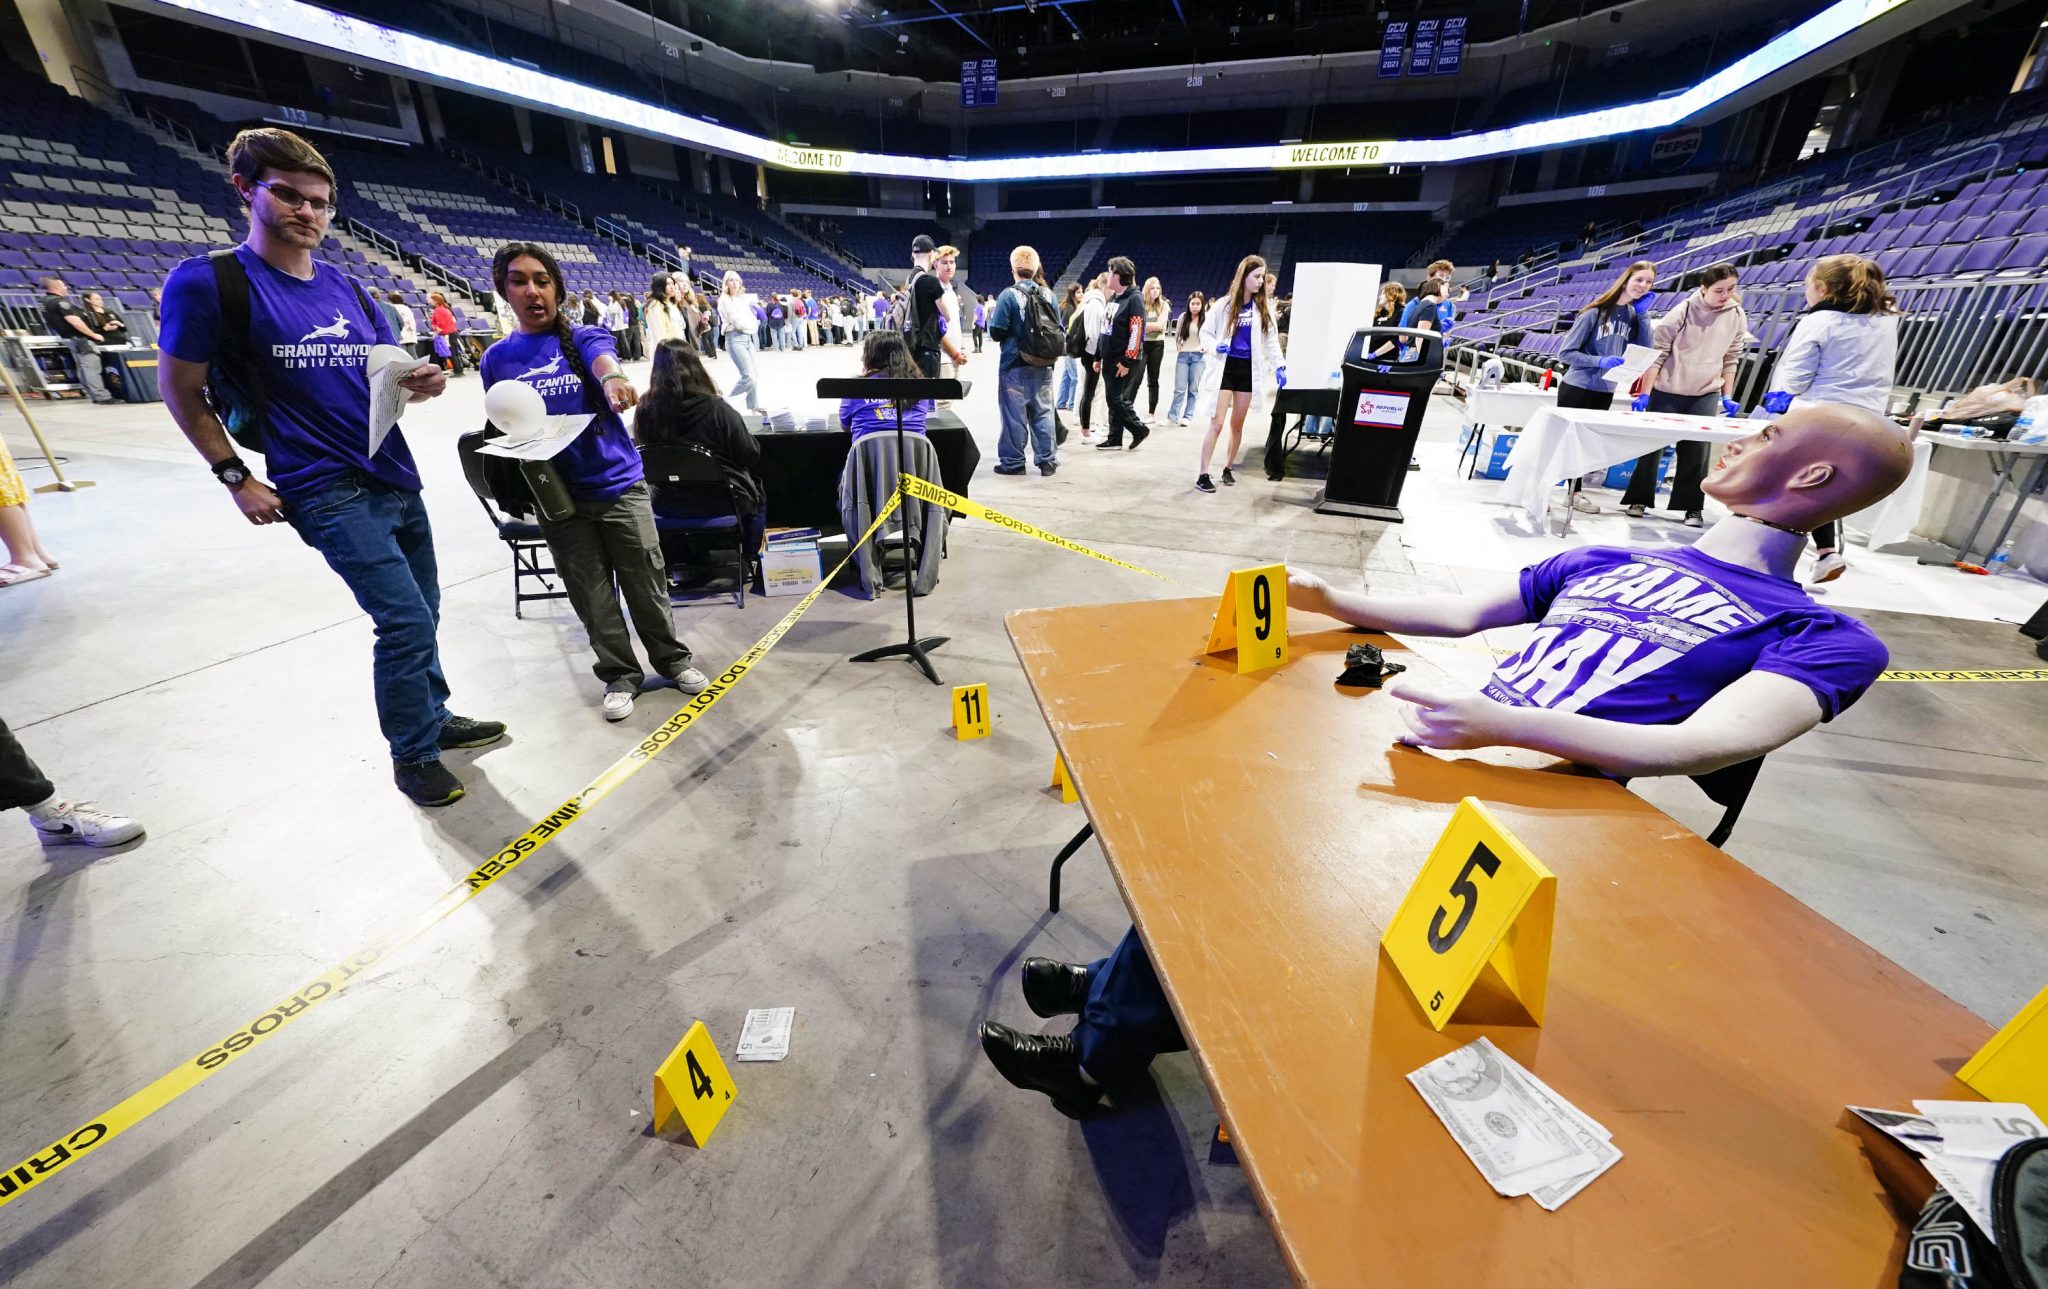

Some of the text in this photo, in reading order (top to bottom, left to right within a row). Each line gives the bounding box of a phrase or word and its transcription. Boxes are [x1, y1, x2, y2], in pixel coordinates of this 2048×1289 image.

[1387, 23, 1408, 33] GCU
[1417, 20, 1439, 31] GCU
[1444, 17, 1467, 29] GCU
[1385, 46, 1402, 54] WAC
[1416, 41, 1434, 49] WAC
[1443, 39, 1461, 47] WAC
[1187, 77, 1203, 87] 208
[1051, 87, 1066, 97] 209
[1292, 145, 1379, 163] WELCOME TO
[1654, 138, 1699, 155] PEPSI
[829, 153, 842, 168] TO
[1353, 202, 1369, 212] 107
[272, 344, 327, 358] GRAND
[285, 357, 366, 369] UNIVERSIT
[536, 374, 582, 389] CANYON
[539, 384, 579, 397] RSITY
[1567, 562, 1757, 634] GAME
[1253, 574, 1272, 641] 9
[1275, 647, 1281, 659] 9
[718, 663, 747, 686] DO
[1495, 624, 1688, 714] DAY
[689, 684, 724, 713] NOT
[961, 688, 981, 725] 11
[630, 712, 692, 761] CROSS
[464, 837, 536, 893] SCEN
[1427, 840, 1502, 955] 5
[1429, 989, 1444, 1012] 5
[196, 981, 332, 1070] CROSS
[685, 1049, 714, 1101] 4
[725, 1090, 731, 1101] 4
[0, 1123, 107, 1197] CRI
